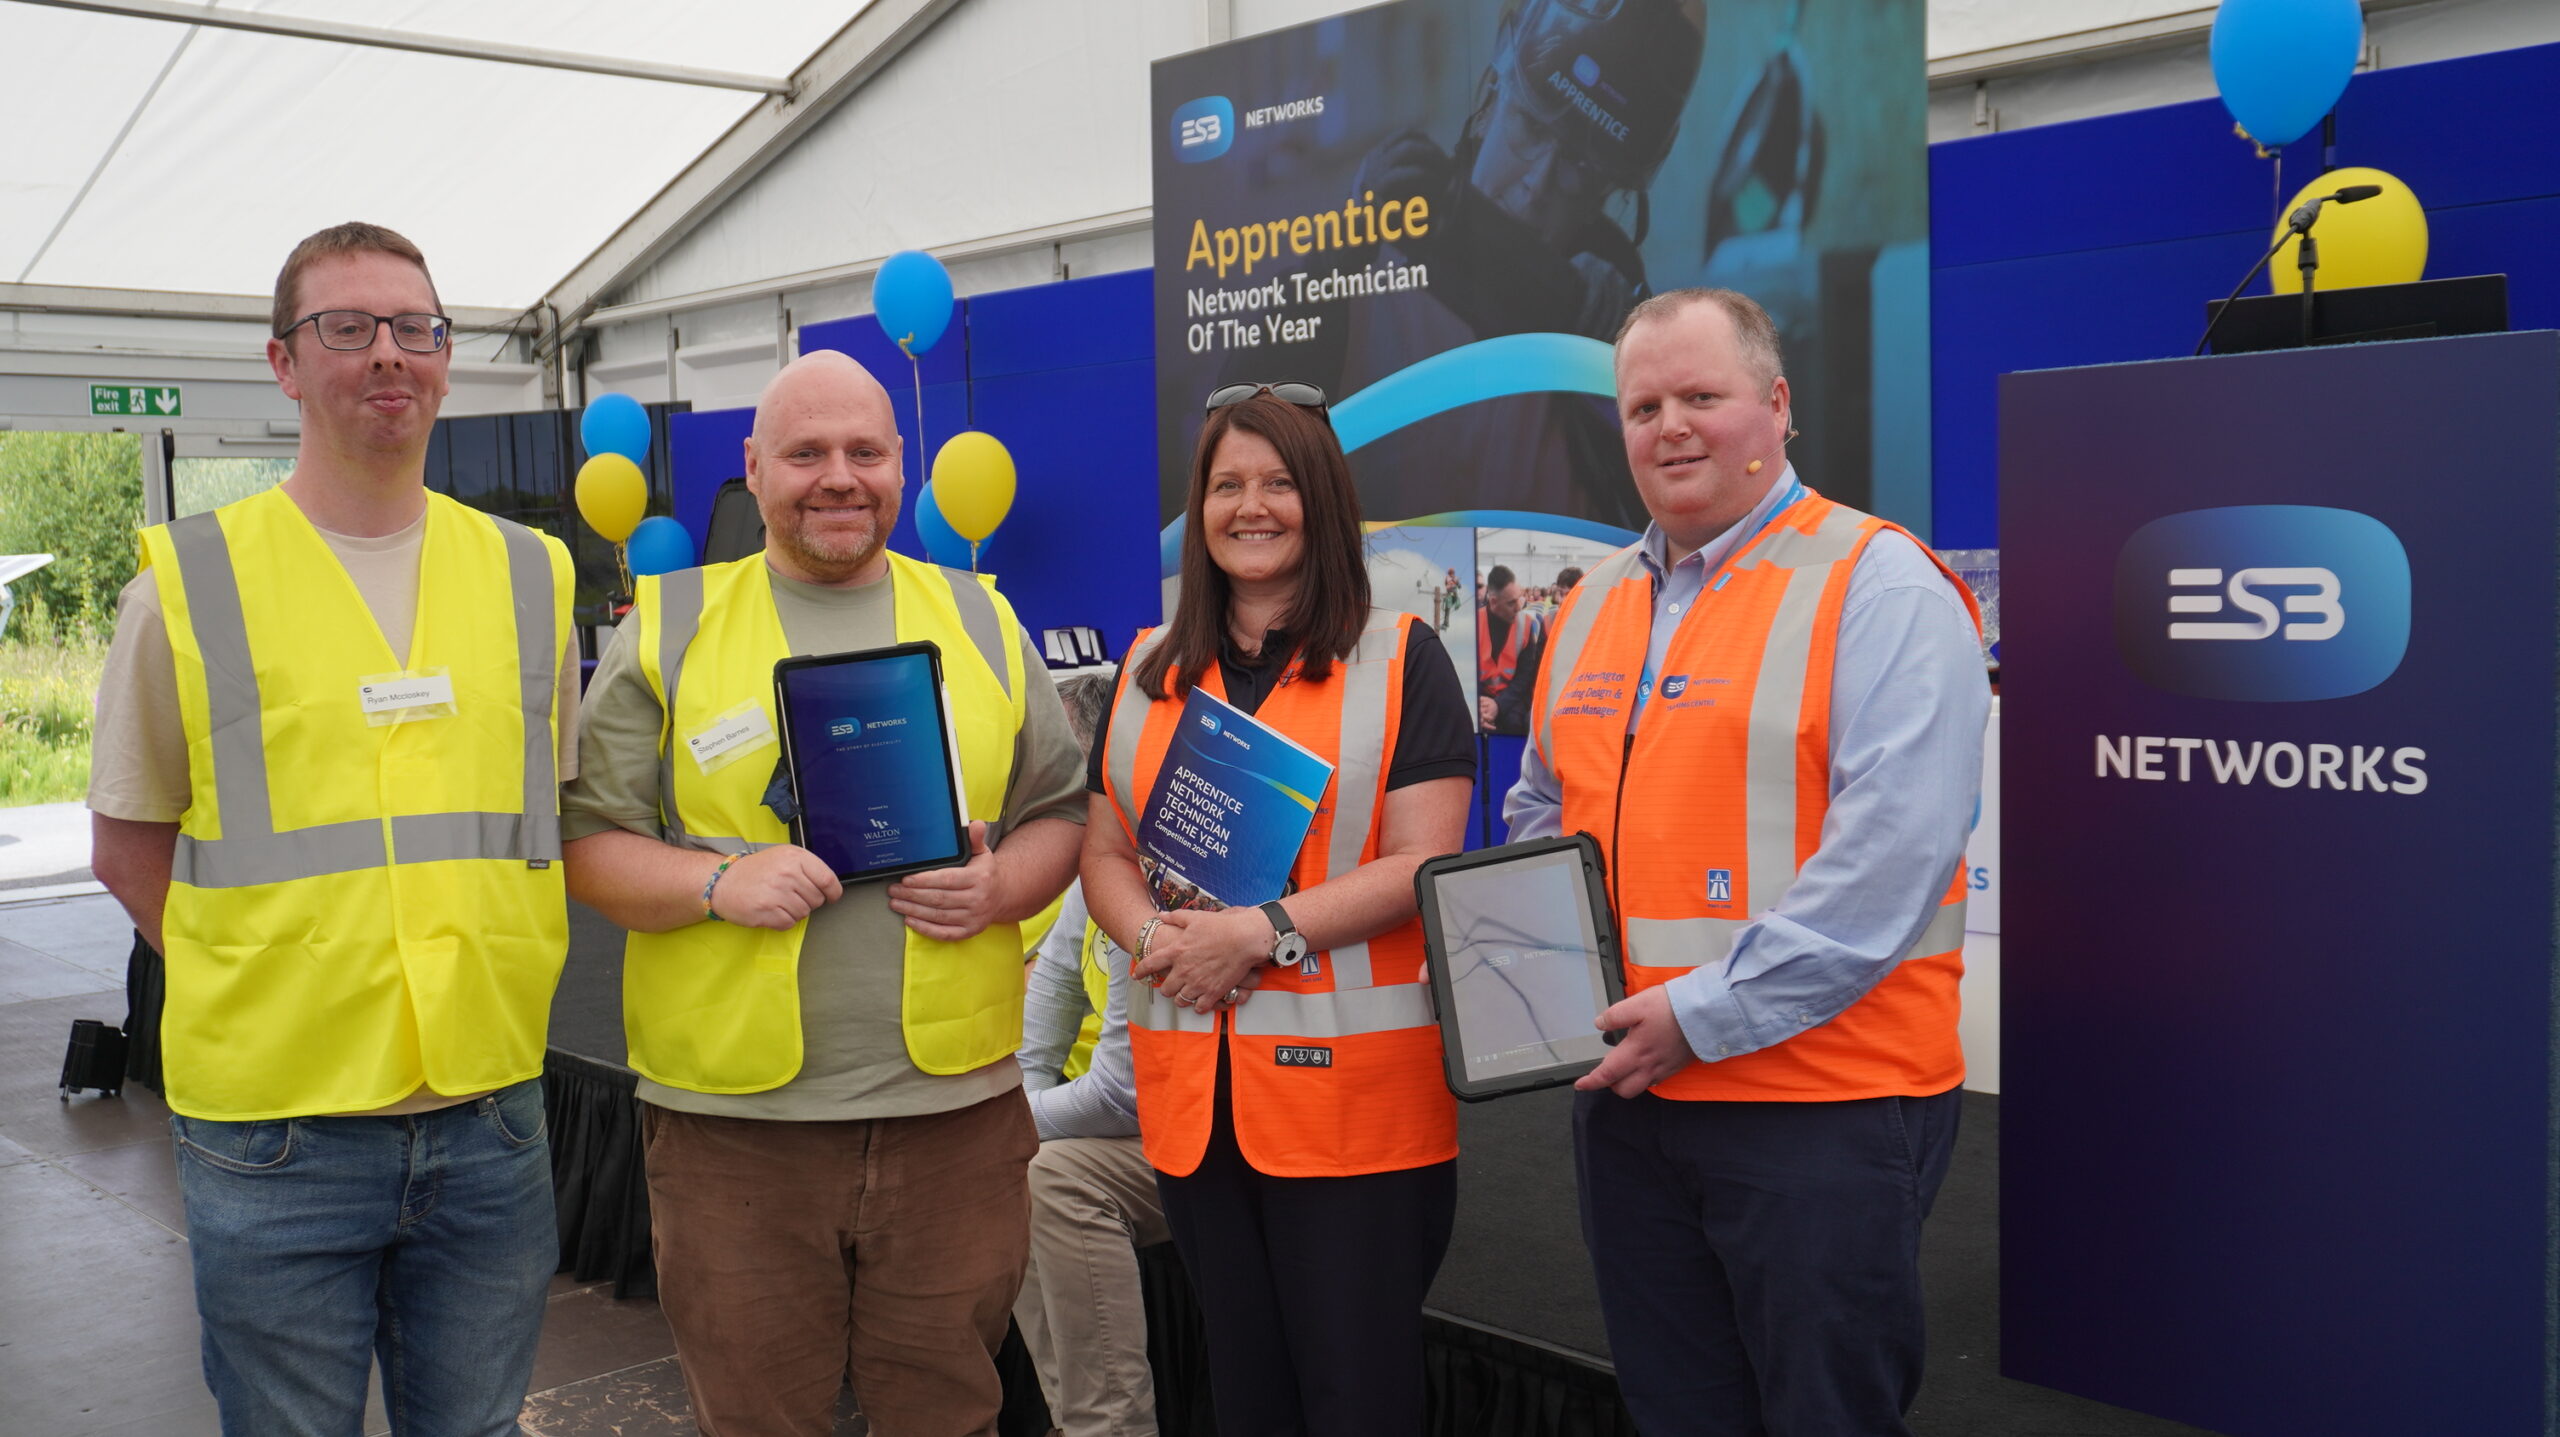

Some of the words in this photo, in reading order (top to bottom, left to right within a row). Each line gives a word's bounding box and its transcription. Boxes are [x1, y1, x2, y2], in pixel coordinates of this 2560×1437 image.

[1182, 114, 1221, 146] ESB
[1245, 96, 1325, 129] NETWORKS
[1547, 71, 1630, 142] APPRENTICE
[1185, 190, 1430, 279] Apprentice
[1187, 277, 1287, 317] Network
[1291, 261, 1429, 303] Technician
[1187, 321, 1215, 352] Of
[1218, 319, 1261, 349] The
[1266, 313, 1322, 344] Year
[95, 387, 119, 399] Fire
[97, 400, 119, 412] exit
[2168, 567, 2345, 641] ESB
[367, 696, 388, 704] Ryan
[831, 723, 855, 736] ESB
[866, 718, 907, 729] NETWORKS
[1201, 715, 1217, 730] ESB
[1223, 730, 1251, 750] NETWORKS
[2095, 734, 2429, 795] NETWORKS
[1170, 778, 1225, 821] NETWORK
[1174, 765, 1244, 815] APPRENTICE
[864, 828, 901, 840] WALTON
[1155, 820, 1192, 849] Competition
[1191, 843, 1209, 859] 2025
[1160, 807, 1175, 822] OF
[1176, 816, 1199, 839] THE
[1200, 831, 1228, 858] YEAR
[1166, 792, 1230, 842] TECHNICIAN
